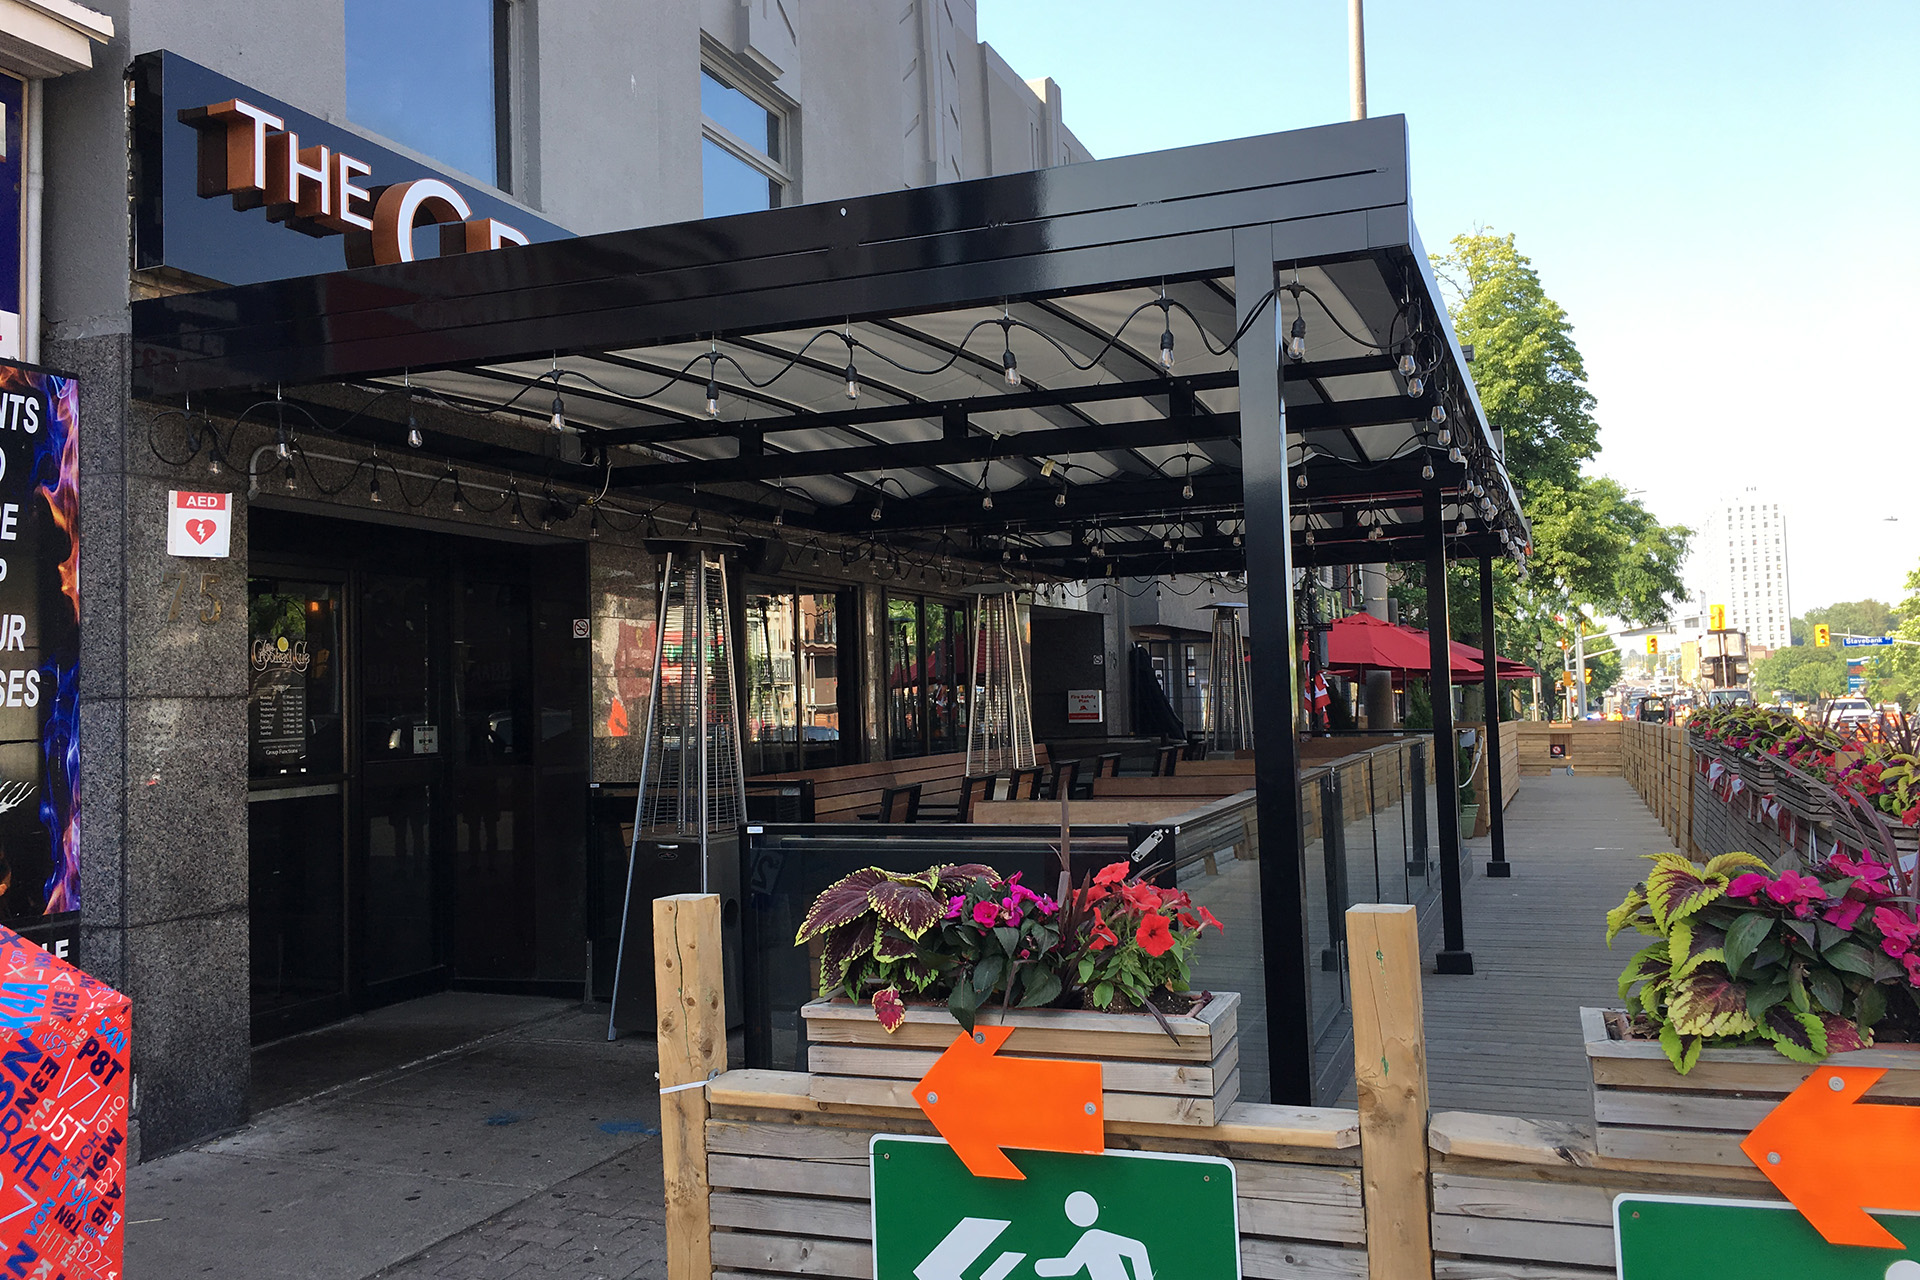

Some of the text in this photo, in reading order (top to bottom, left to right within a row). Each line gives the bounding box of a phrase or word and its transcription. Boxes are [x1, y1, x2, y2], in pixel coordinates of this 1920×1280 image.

[228, 98, 373, 230] THE
[186, 495, 218, 508] AED
[77, 1035, 125, 1087] P8T
[41, 1107, 87, 1151] J5T
